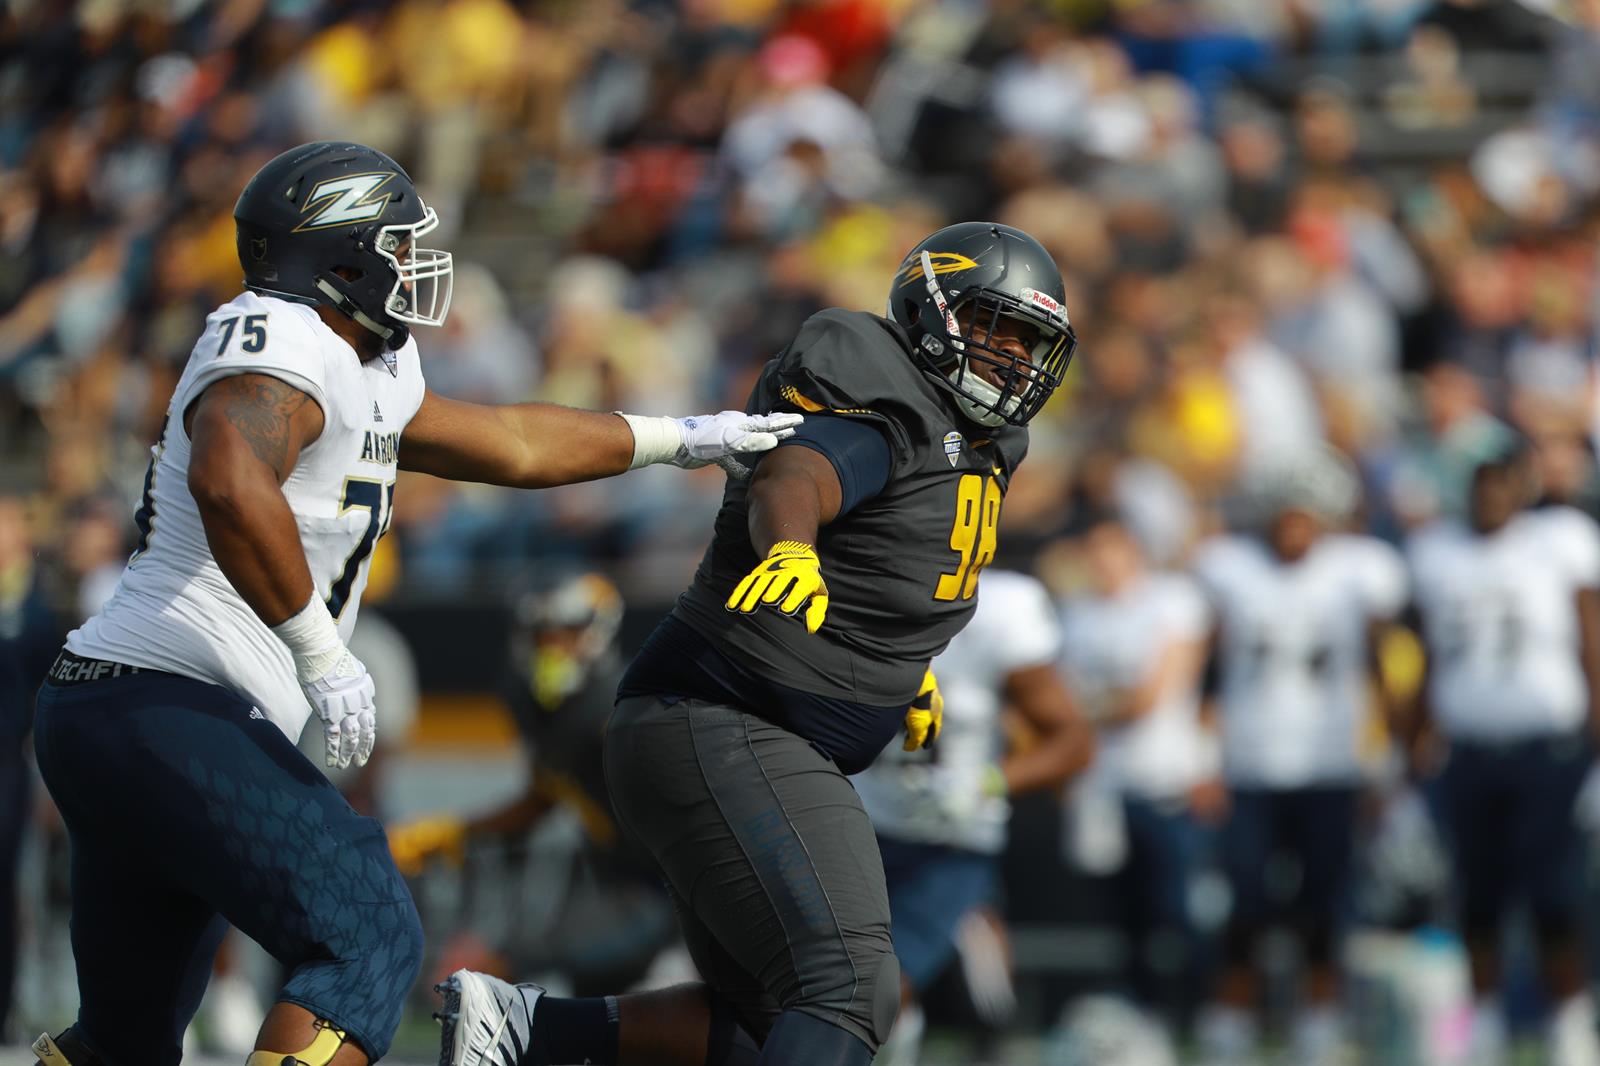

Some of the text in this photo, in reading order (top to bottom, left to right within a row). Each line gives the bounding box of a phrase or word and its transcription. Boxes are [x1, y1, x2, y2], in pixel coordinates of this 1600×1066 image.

[291, 171, 397, 232] Z
[1033, 291, 1058, 311] Riddell
[217, 314, 268, 357] 75
[359, 429, 399, 465] AKRON
[934, 474, 1001, 600] 98
